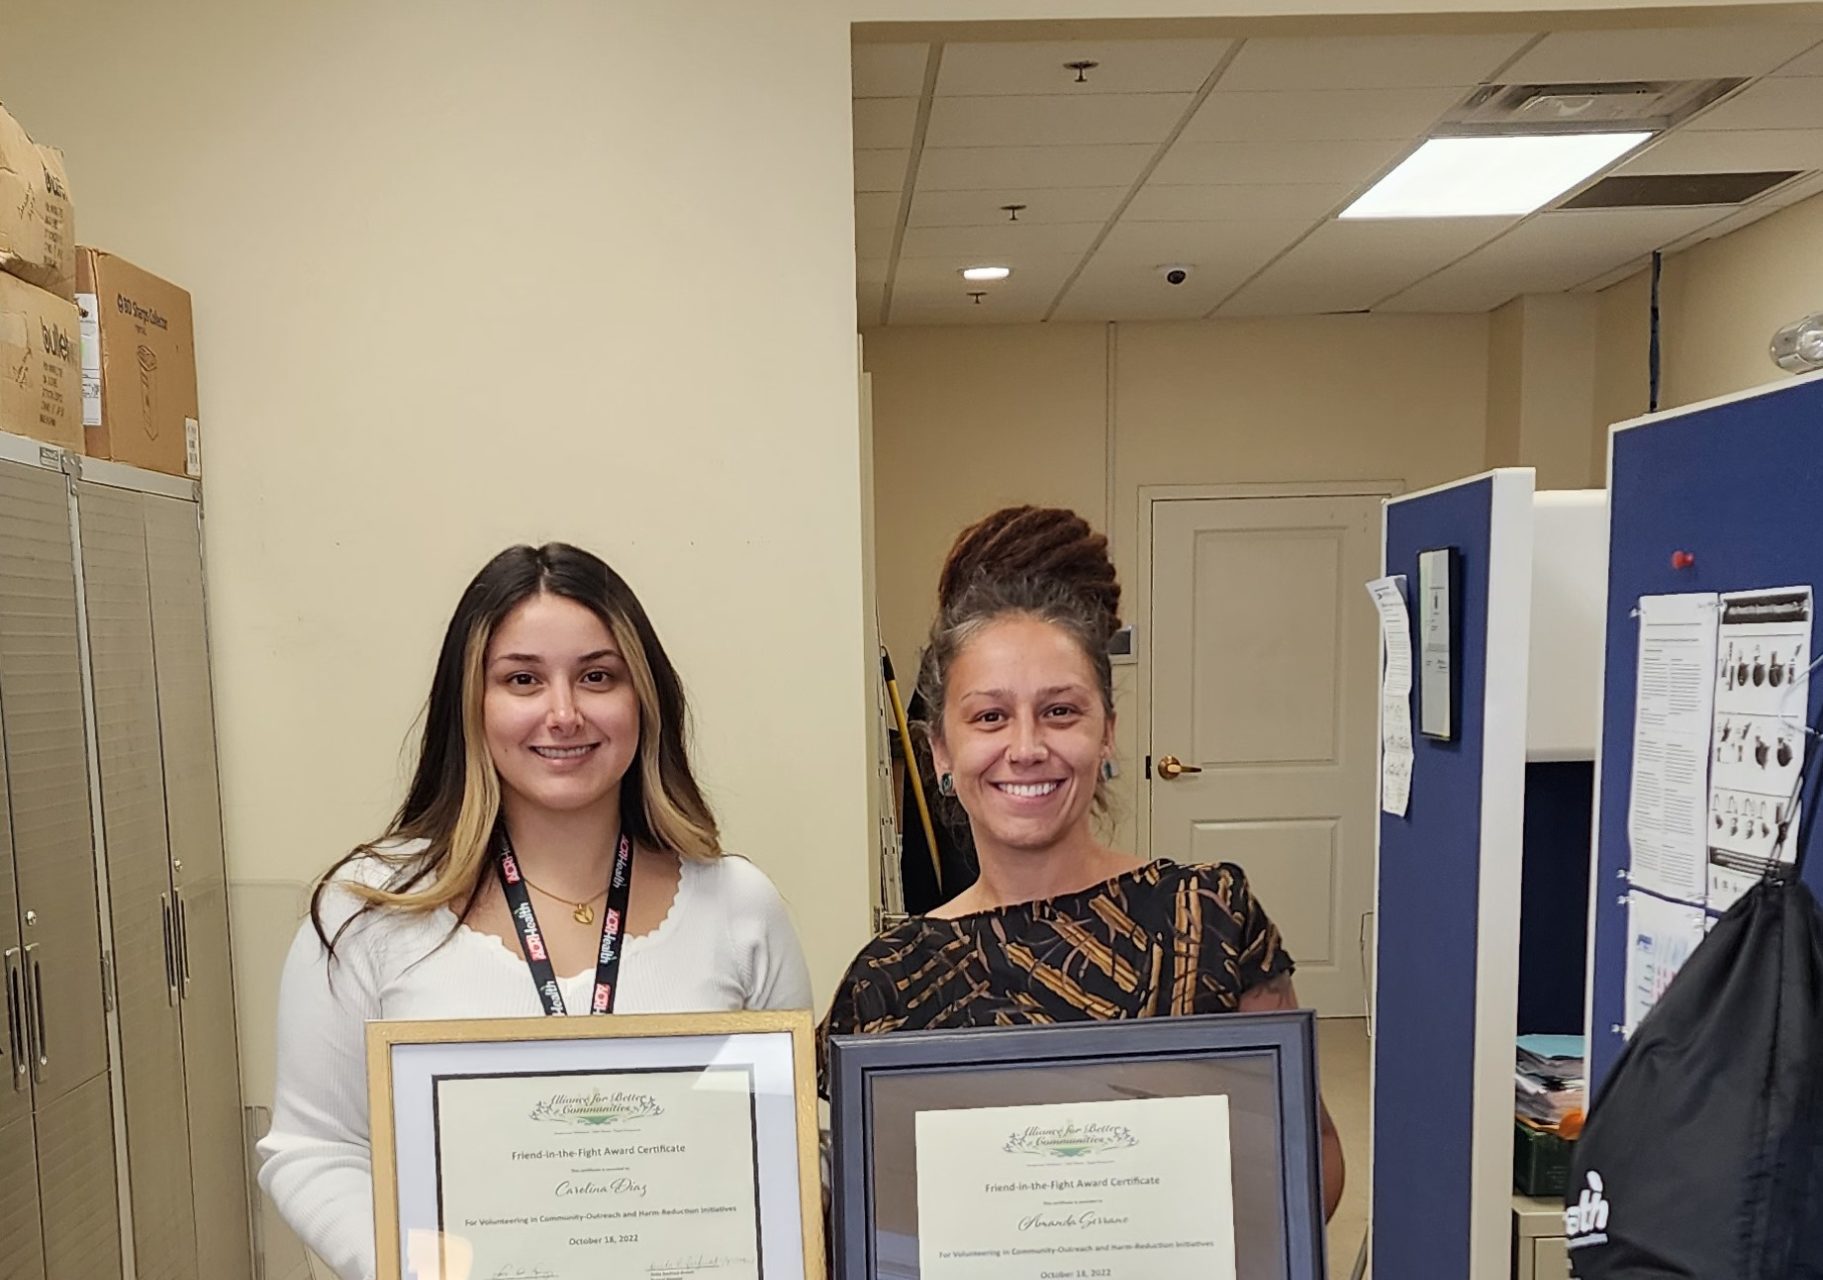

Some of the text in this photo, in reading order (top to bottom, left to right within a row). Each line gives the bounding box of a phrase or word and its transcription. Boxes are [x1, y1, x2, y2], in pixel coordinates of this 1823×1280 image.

[589, 1092, 608, 1106] for
[1063, 1124, 1082, 1138] for
[511, 1144, 686, 1161] Friend-in-the-Fight Award Certificate
[985, 1176, 1160, 1193] Friend-in-the-Fight Award Certificate
[465, 1218, 477, 1227] For
[479, 1217, 528, 1226] Volunteering
[623, 1210, 637, 1218] and
[700, 1205, 737, 1214] Initiatives
[568, 1237, 602, 1246] October
[618, 1233, 639, 1243] 2022
[939, 1251, 951, 1259] For
[952, 1249, 1001, 1258] Volunteering
[1095, 1244, 1109, 1252] and
[1040, 1271, 1074, 1280] October
[1090, 1268, 1112, 1278] 2022
